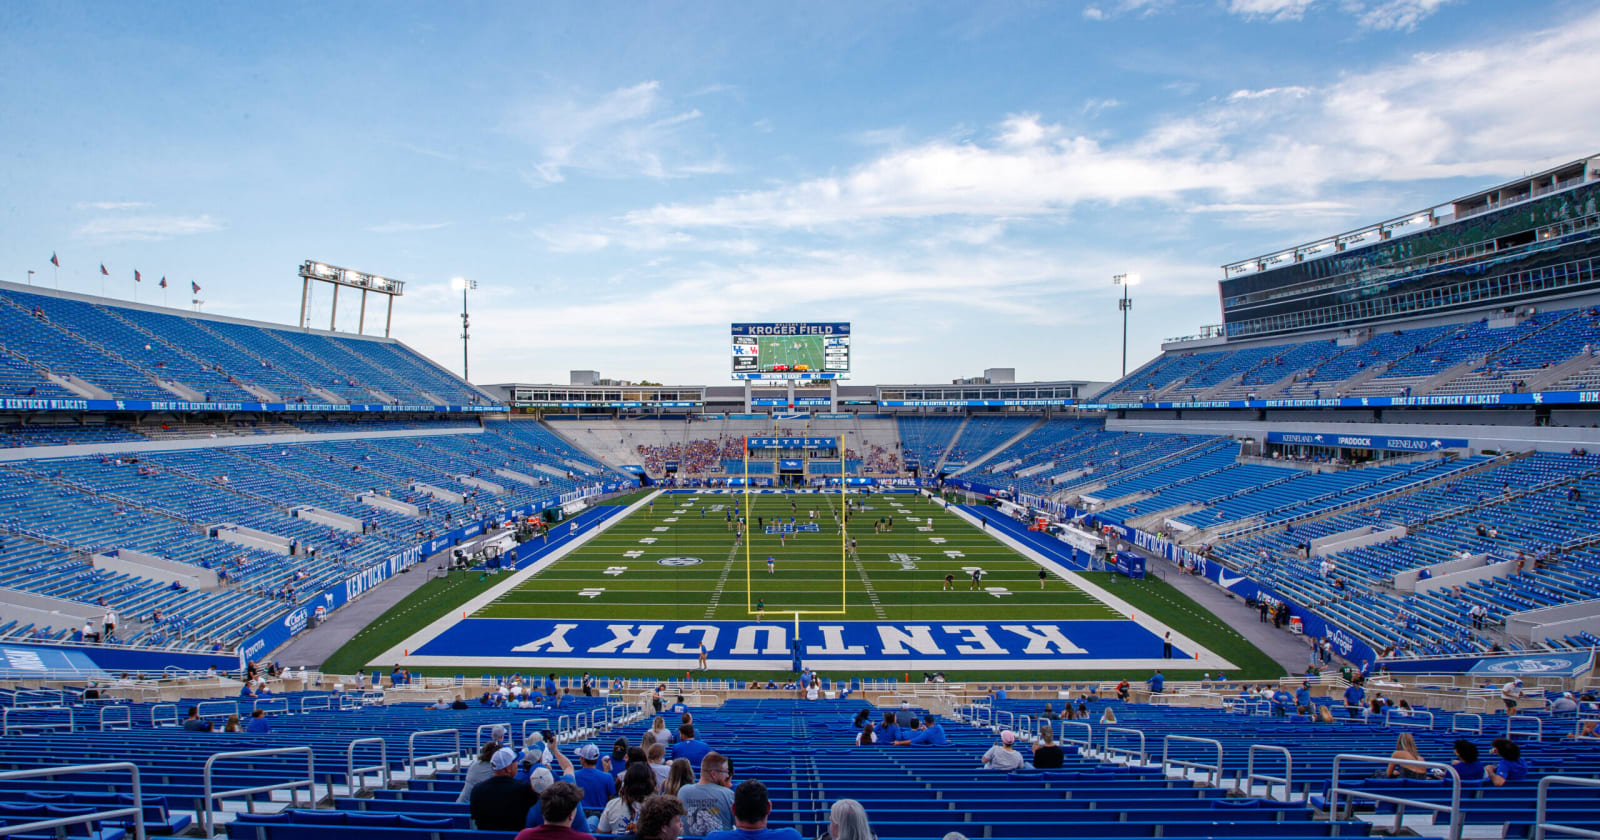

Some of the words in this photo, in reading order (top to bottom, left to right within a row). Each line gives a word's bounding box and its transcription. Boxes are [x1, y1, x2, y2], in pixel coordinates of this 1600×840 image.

[748, 326, 796, 335] KROGER
[800, 326, 833, 335] FIELD
[6, 399, 48, 409] KENTUCKY
[50, 399, 88, 410] WILDCATS
[1391, 397, 1407, 406] HOME
[1408, 397, 1416, 406] OF
[1417, 396, 1430, 405] THE
[1430, 396, 1464, 405] KENTUCKY
[1465, 394, 1500, 404] WILDCATS
[1282, 434, 1313, 443] KEENELAND
[1341, 437, 1371, 446] PADDOCK
[1387, 439, 1428, 449] KEENELAND
[1134, 527, 1169, 559] KENTUCKY
[346, 560, 388, 603] KENTUCKY
[390, 544, 423, 577] WILDCATS
[510, 623, 1089, 655] KENTUCKY
[245, 638, 265, 659] TOYOTA
